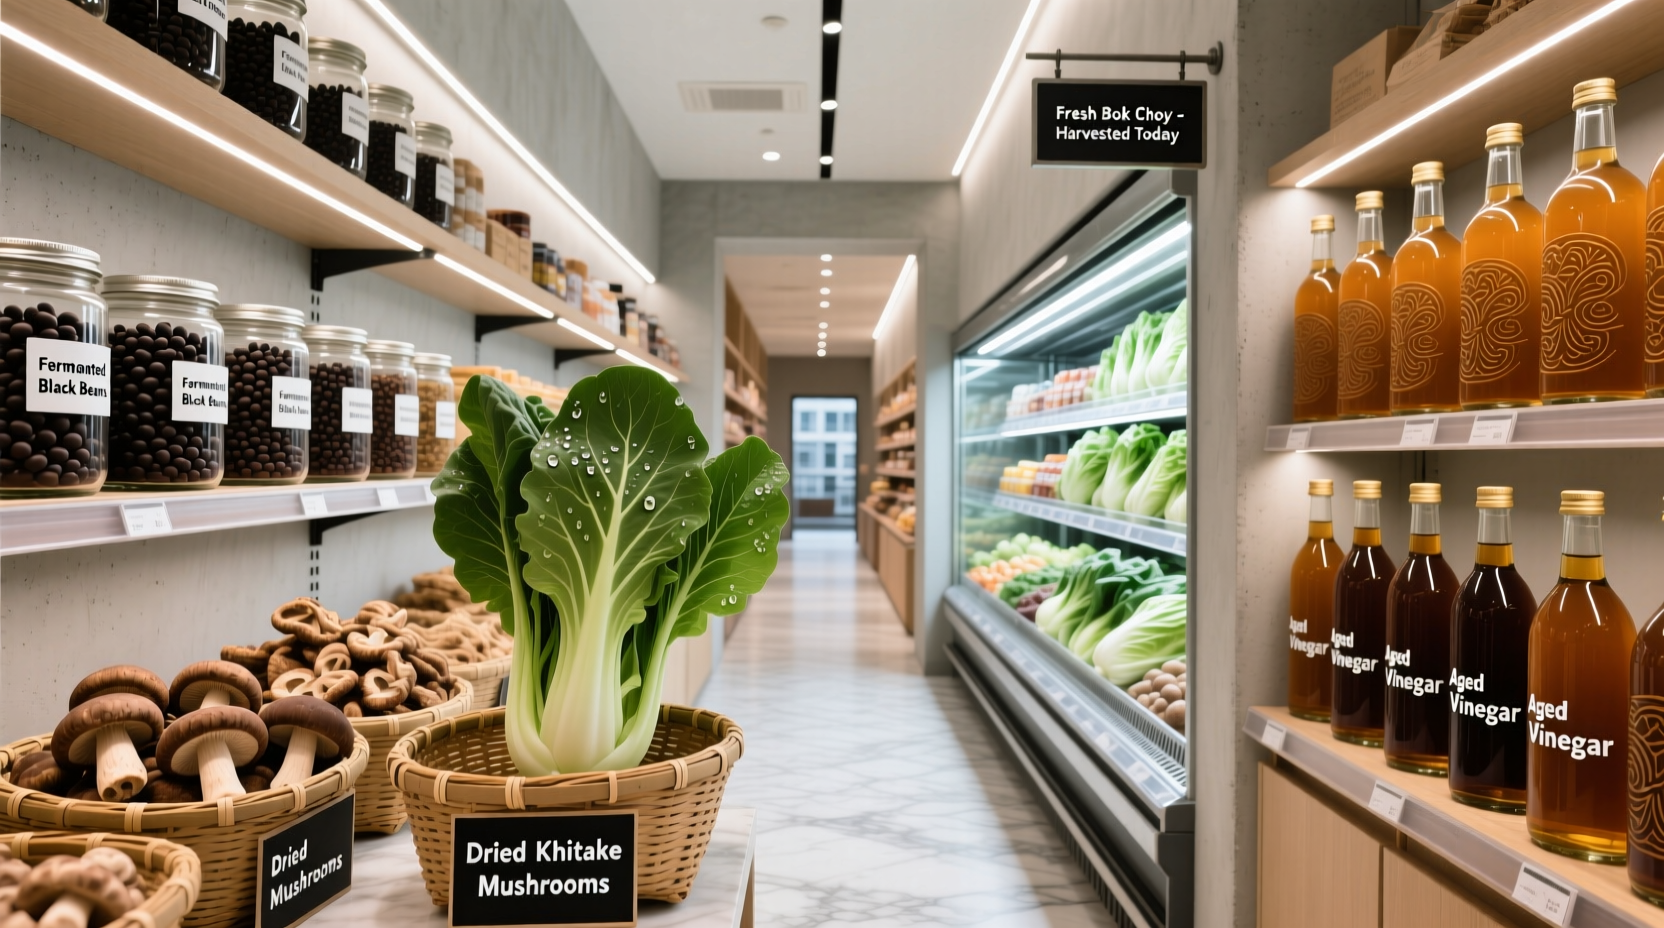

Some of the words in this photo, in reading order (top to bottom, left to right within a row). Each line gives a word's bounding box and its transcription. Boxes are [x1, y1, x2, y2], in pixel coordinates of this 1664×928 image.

[1056, 106, 1097, 120] Fresh
[1102, 106, 1131, 120] Bok
[1135, 107, 1173, 125] Choy
[1056, 126, 1130, 141] Harvested
[1134, 126, 1180, 145] Today
[38, 378, 76, 395] Black
[1331, 627, 1354, 649] Aged
[1384, 644, 1411, 667] Aged
[1385, 667, 1444, 697] Vinegar
[1449, 667, 1485, 693] Aged
[1450, 691, 1522, 726] Vinegar
[1528, 693, 1568, 721] Aged
[1529, 720, 1614, 760] Vinegar
[271, 838, 308, 878] Dried
[466, 840, 526, 864] Dried
[536, 838, 622, 862] Khitake
[478, 872, 610, 897] Mushrooms
